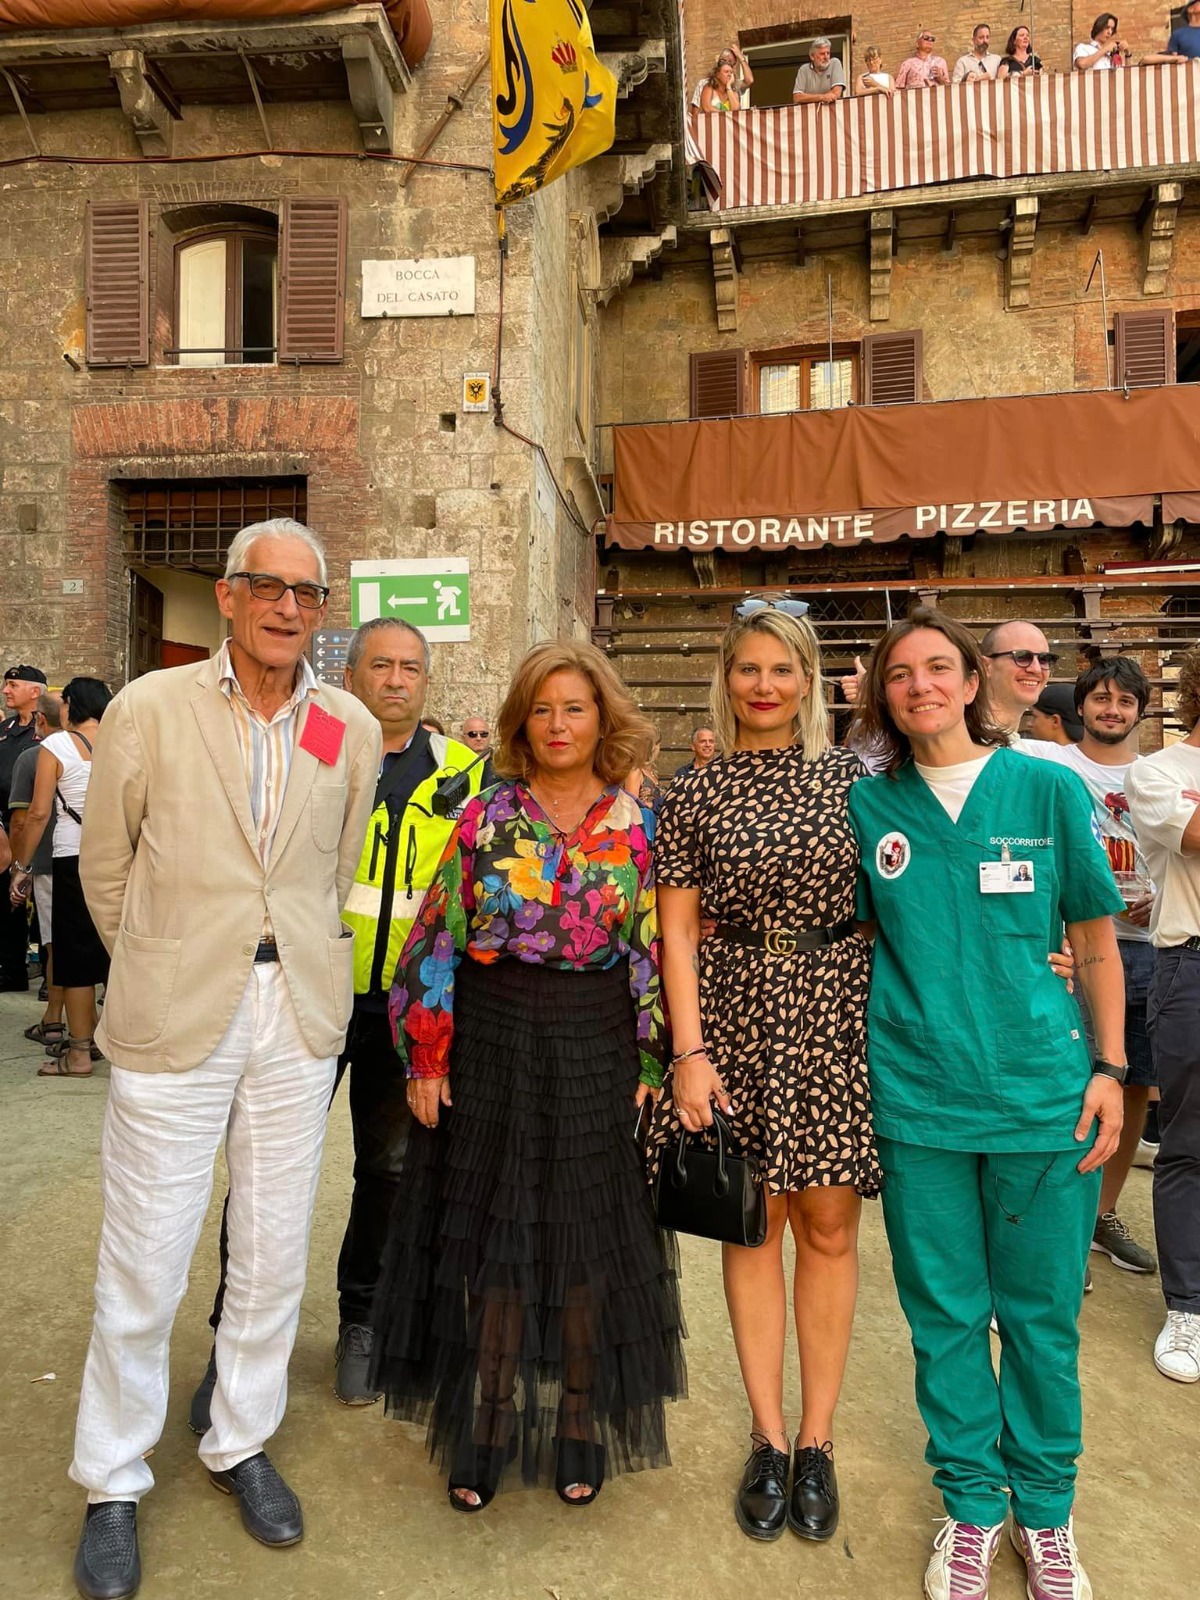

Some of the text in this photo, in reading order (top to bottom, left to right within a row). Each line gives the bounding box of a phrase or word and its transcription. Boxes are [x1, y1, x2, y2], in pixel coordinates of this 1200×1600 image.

[395, 269, 440, 281] BOCCA
[377, 291, 459, 303] DEL CASATO
[654, 498, 1095, 545] RISTORANTE PIZZERIA
[69, 581, 77, 592] 2
